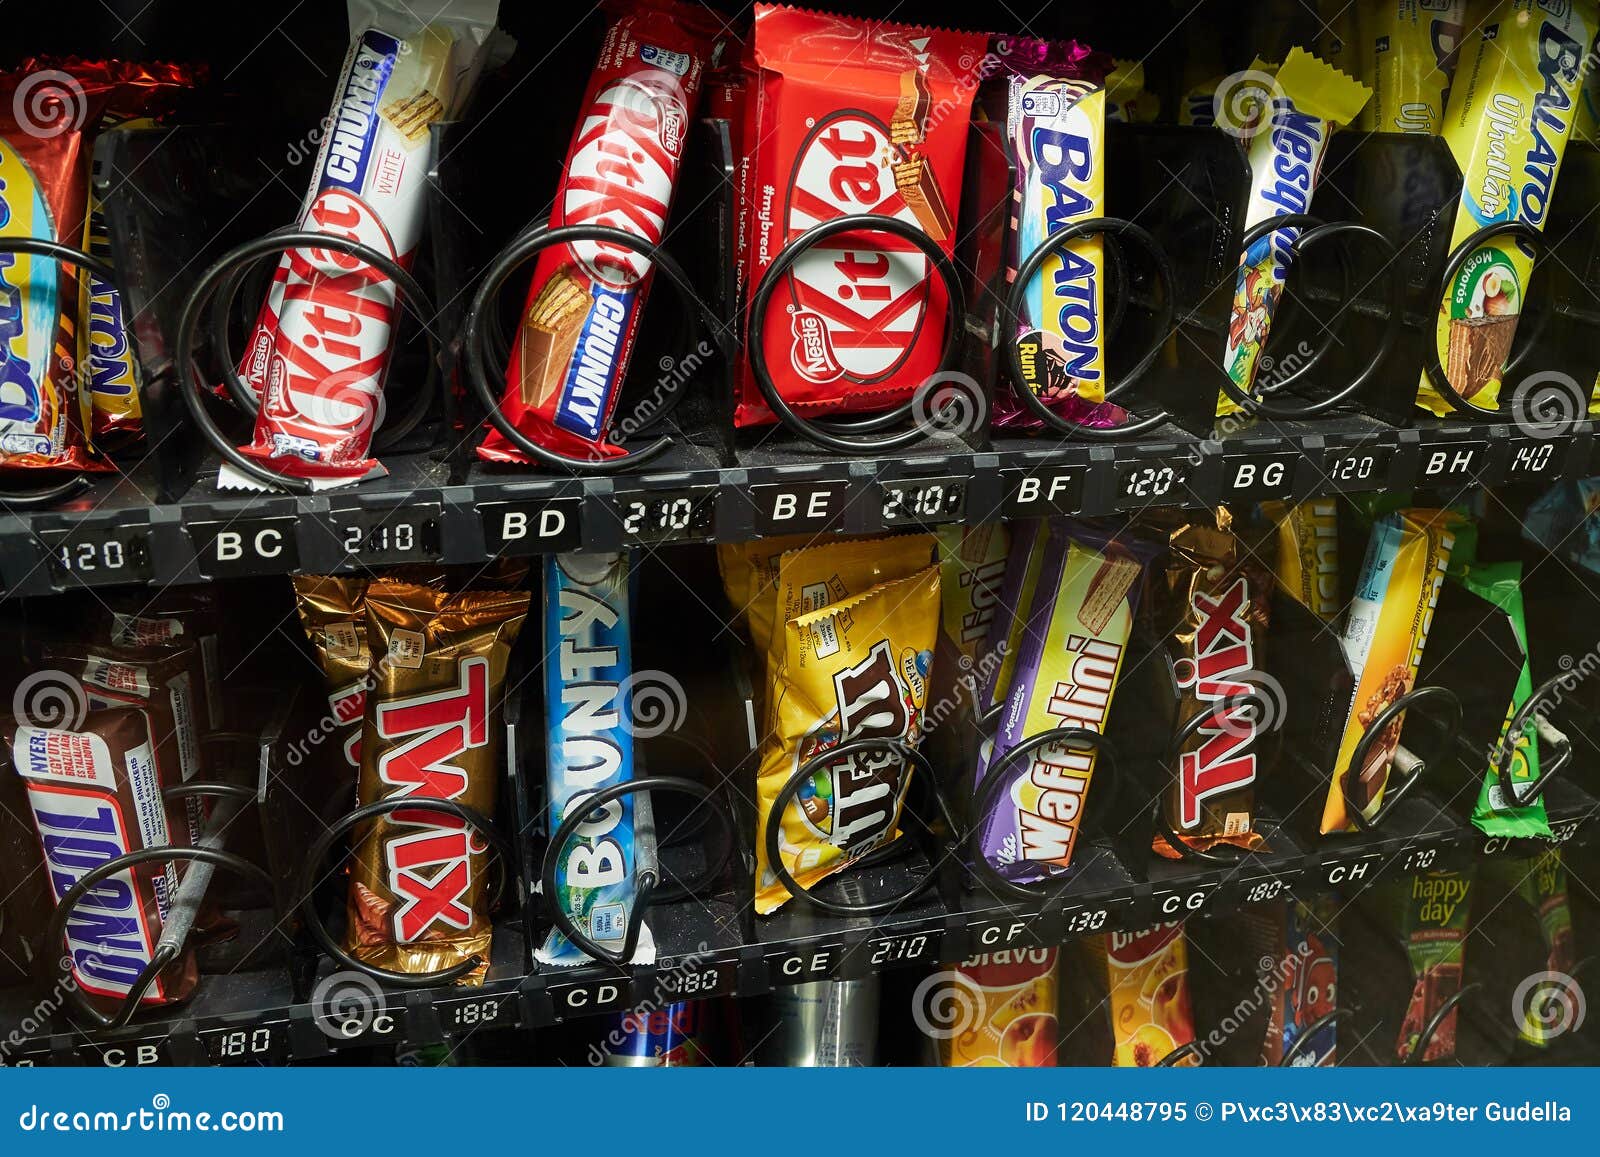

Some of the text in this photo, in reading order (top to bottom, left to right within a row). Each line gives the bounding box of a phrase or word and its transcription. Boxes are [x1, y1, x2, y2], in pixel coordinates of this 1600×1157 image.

[326, 44, 383, 183] CHUNKY
[665, 102, 683, 153] Nestlé
[1480, 93, 1526, 220] Újhullám
[1513, 20, 1584, 260] BALATON
[377, 149, 401, 196] WHITE
[758, 184, 776, 267] #mybreak
[793, 127, 927, 348] KitKat
[1031, 126, 1102, 381] BALATON
[1456, 250, 1493, 305] Mogyorós
[274, 199, 396, 412] KitKat
[567, 294, 626, 428] CHUNKY
[801, 316, 830, 374] Nestlé
[1019, 342, 1039, 378] Rum
[1330, 456, 1374, 481] 120
[1510, 444, 1555, 472] 140
[904, 655, 926, 701] PEANUT
[1172, 577, 1257, 830] TWIX
[29, 728, 49, 775] NYERJ
[558, 588, 627, 889] BOUNTY
[1018, 633, 1123, 863] Waffelini
[50, 754, 64, 776] EGY
[129, 756, 144, 800] SNICKERS
[374, 655, 490, 944] TWIX
[1403, 850, 1437, 870] 170
[1412, 876, 1470, 903] happy
[1420, 901, 1456, 927] day
[1068, 909, 1108, 933] 130
[676, 969, 719, 994] 180
[455, 1000, 498, 1024] 180
[221, 1028, 271, 1058] 180
